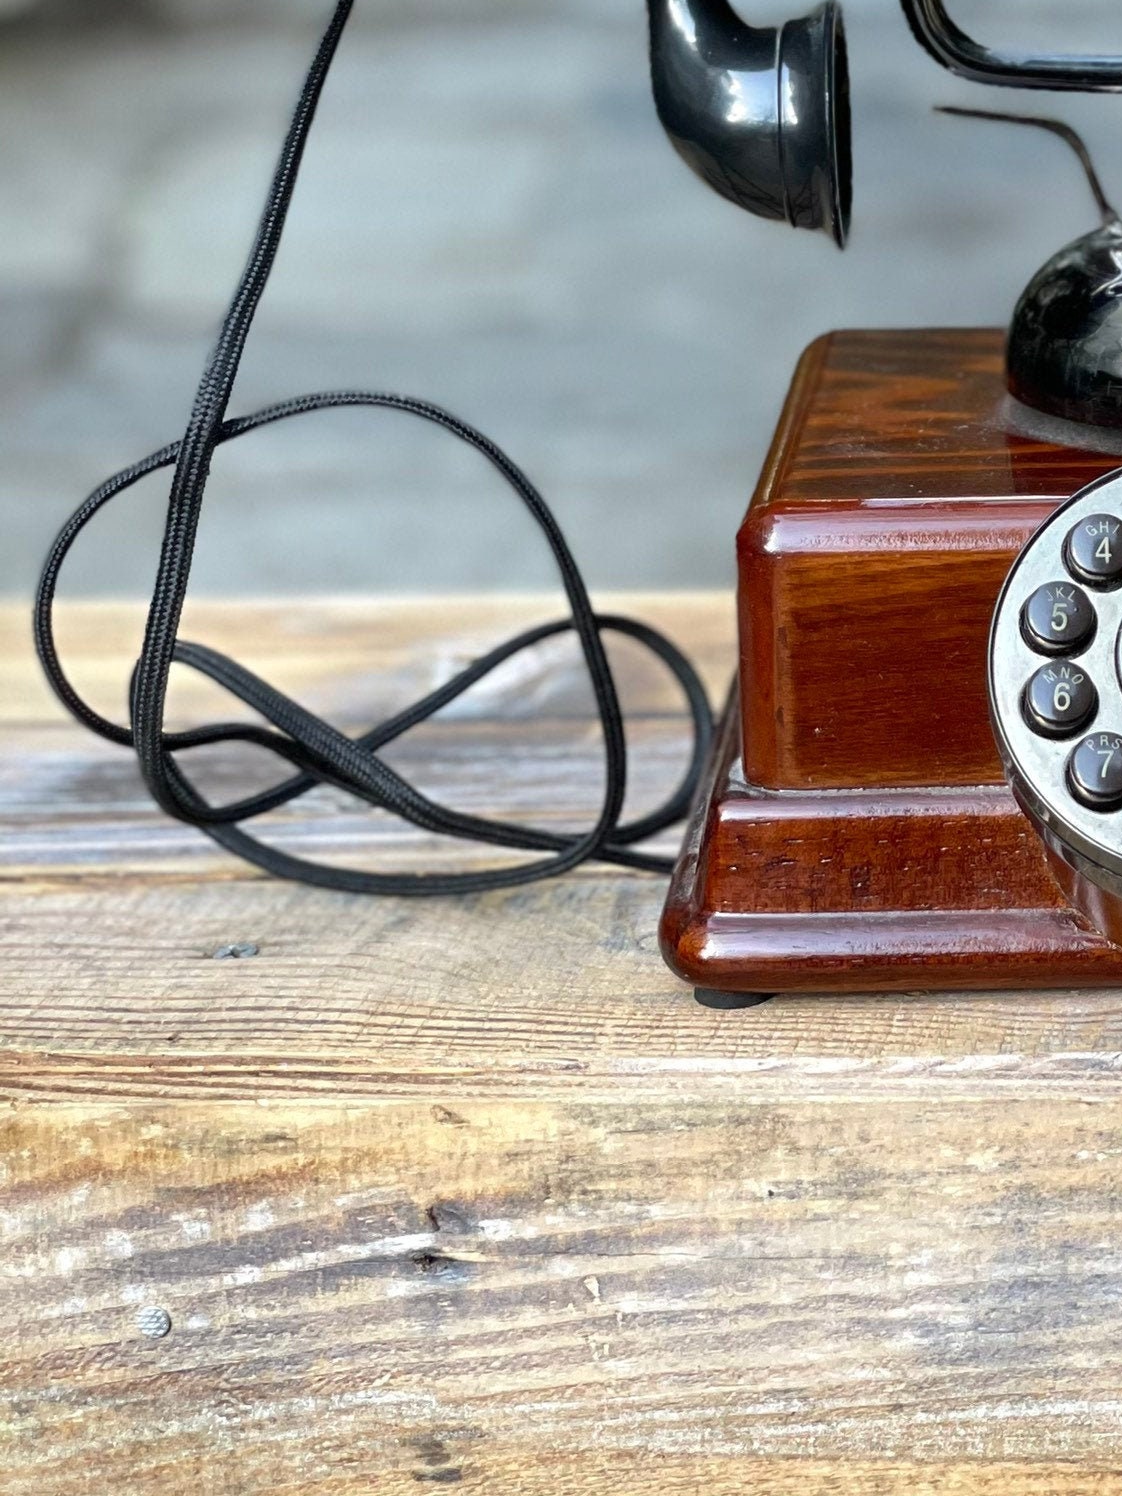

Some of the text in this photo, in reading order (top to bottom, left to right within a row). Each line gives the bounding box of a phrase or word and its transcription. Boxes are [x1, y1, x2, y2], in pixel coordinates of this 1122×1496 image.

[1085, 521, 1118, 536] GHI
[1095, 536, 1112, 563] 4
[1051, 603, 1068, 631] 5
[1042, 666, 1084, 684] MNO
[1053, 682, 1070, 711] 6
[1085, 735, 1122, 751] PRS
[1097, 750, 1114, 778] 7
